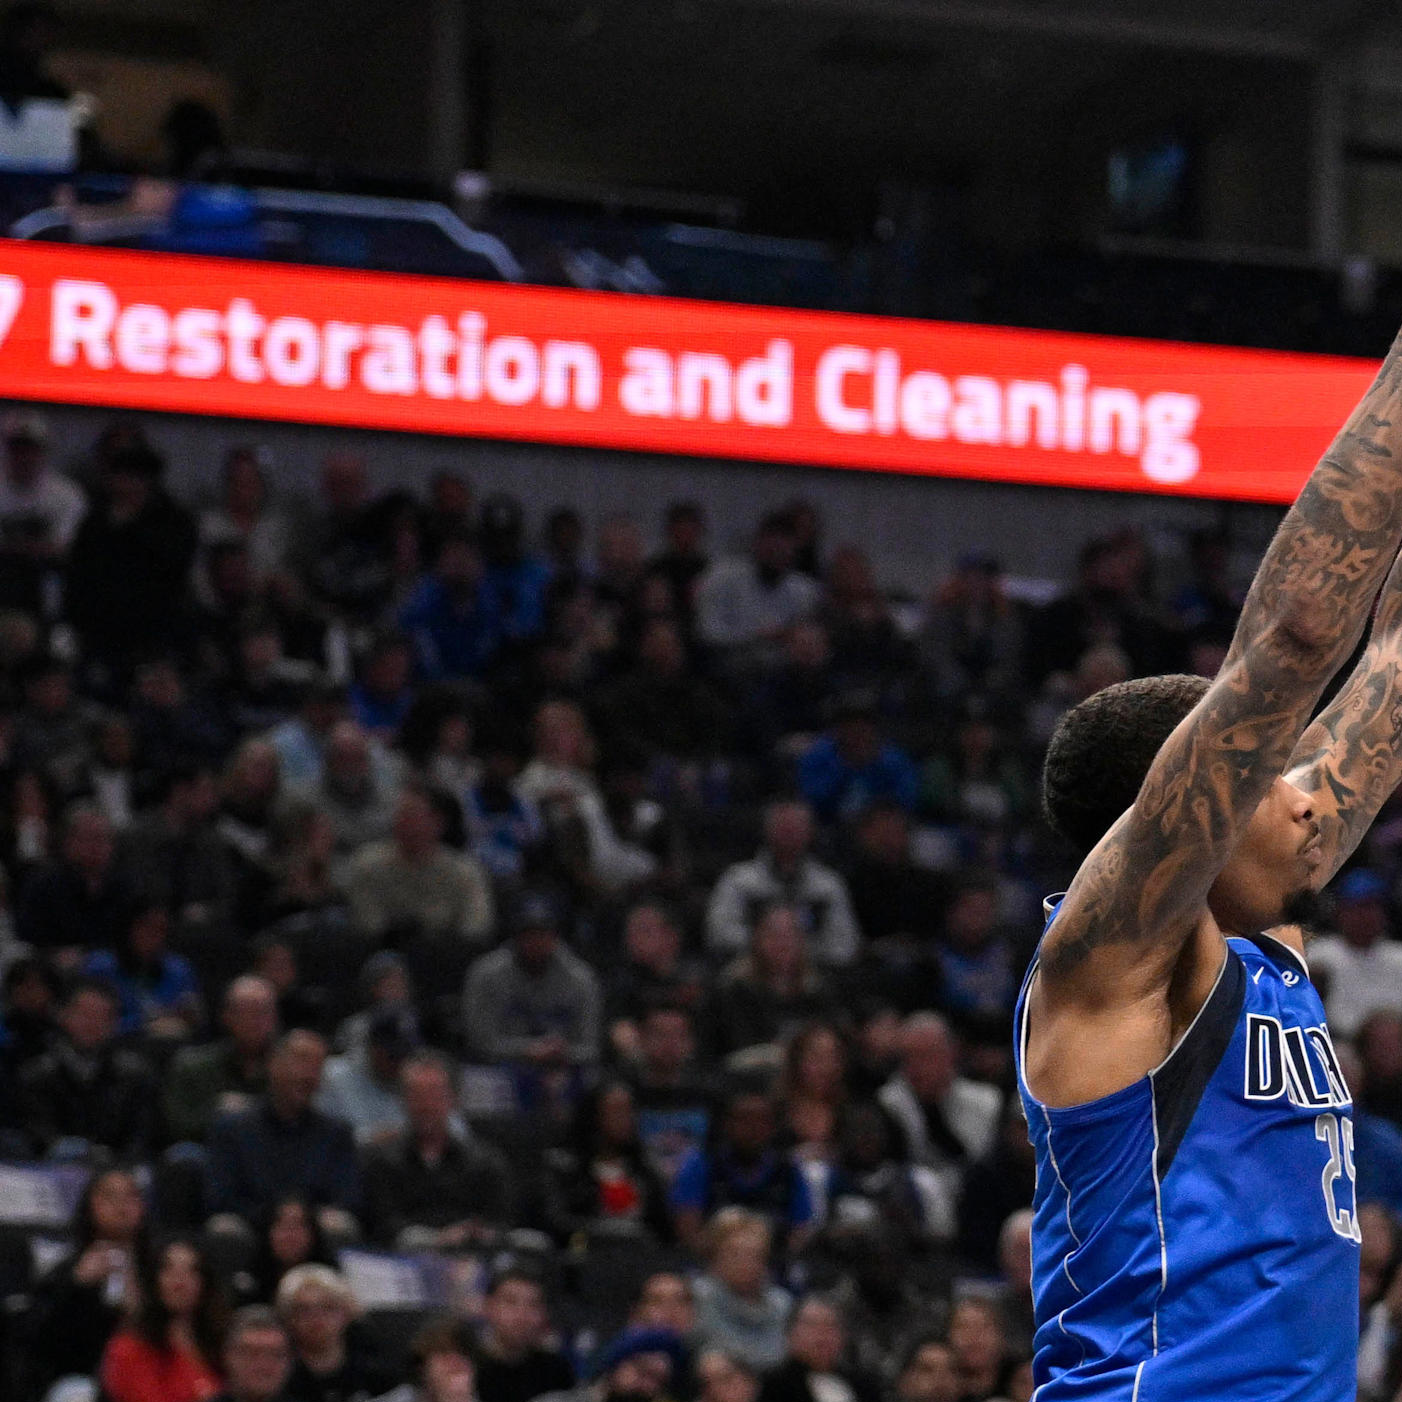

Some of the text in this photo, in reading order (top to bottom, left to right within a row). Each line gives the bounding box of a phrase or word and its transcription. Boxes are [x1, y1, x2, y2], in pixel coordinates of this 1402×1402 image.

[50, 278, 599, 411] Restoration
[619, 338, 794, 428] and
[815, 345, 1199, 483] Cleaning
